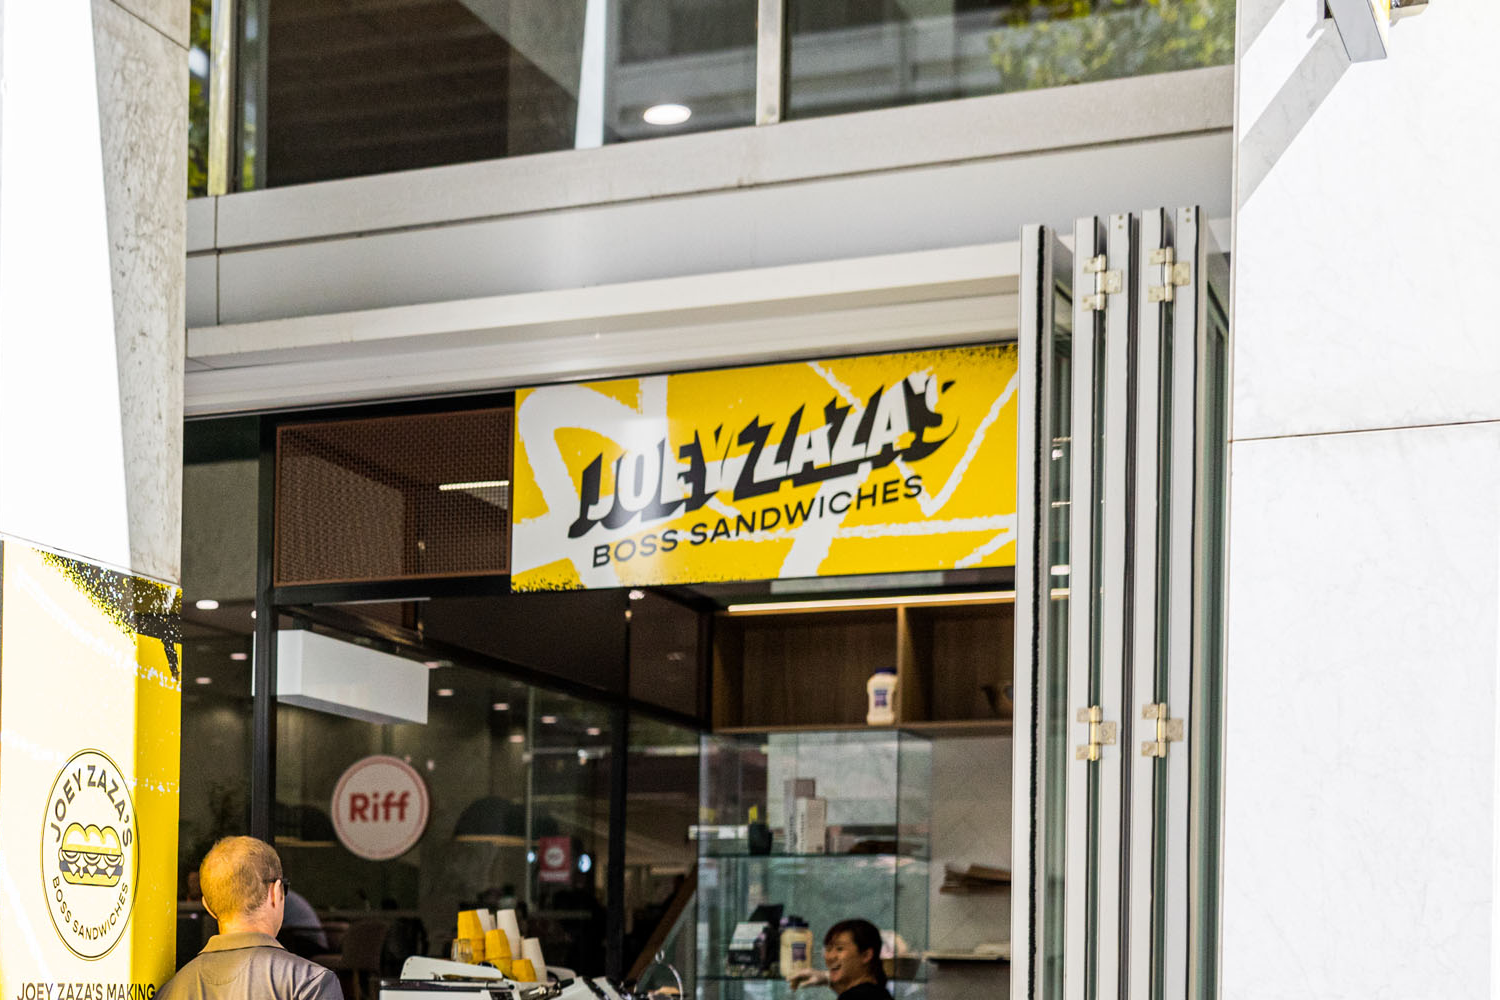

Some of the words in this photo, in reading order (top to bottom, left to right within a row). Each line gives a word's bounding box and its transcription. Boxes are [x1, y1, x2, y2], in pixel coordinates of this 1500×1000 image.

[567, 422, 733, 539] JOEY
[592, 529, 678, 569] BOSS
[689, 474, 923, 547] SANDWICHES
[51, 767, 82, 843] JOEY
[87, 765, 133, 848] ZAZA'S
[349, 791, 410, 823] Riff
[52, 876, 73, 925] BOSS
[72, 882, 129, 941] SANDWICHES
